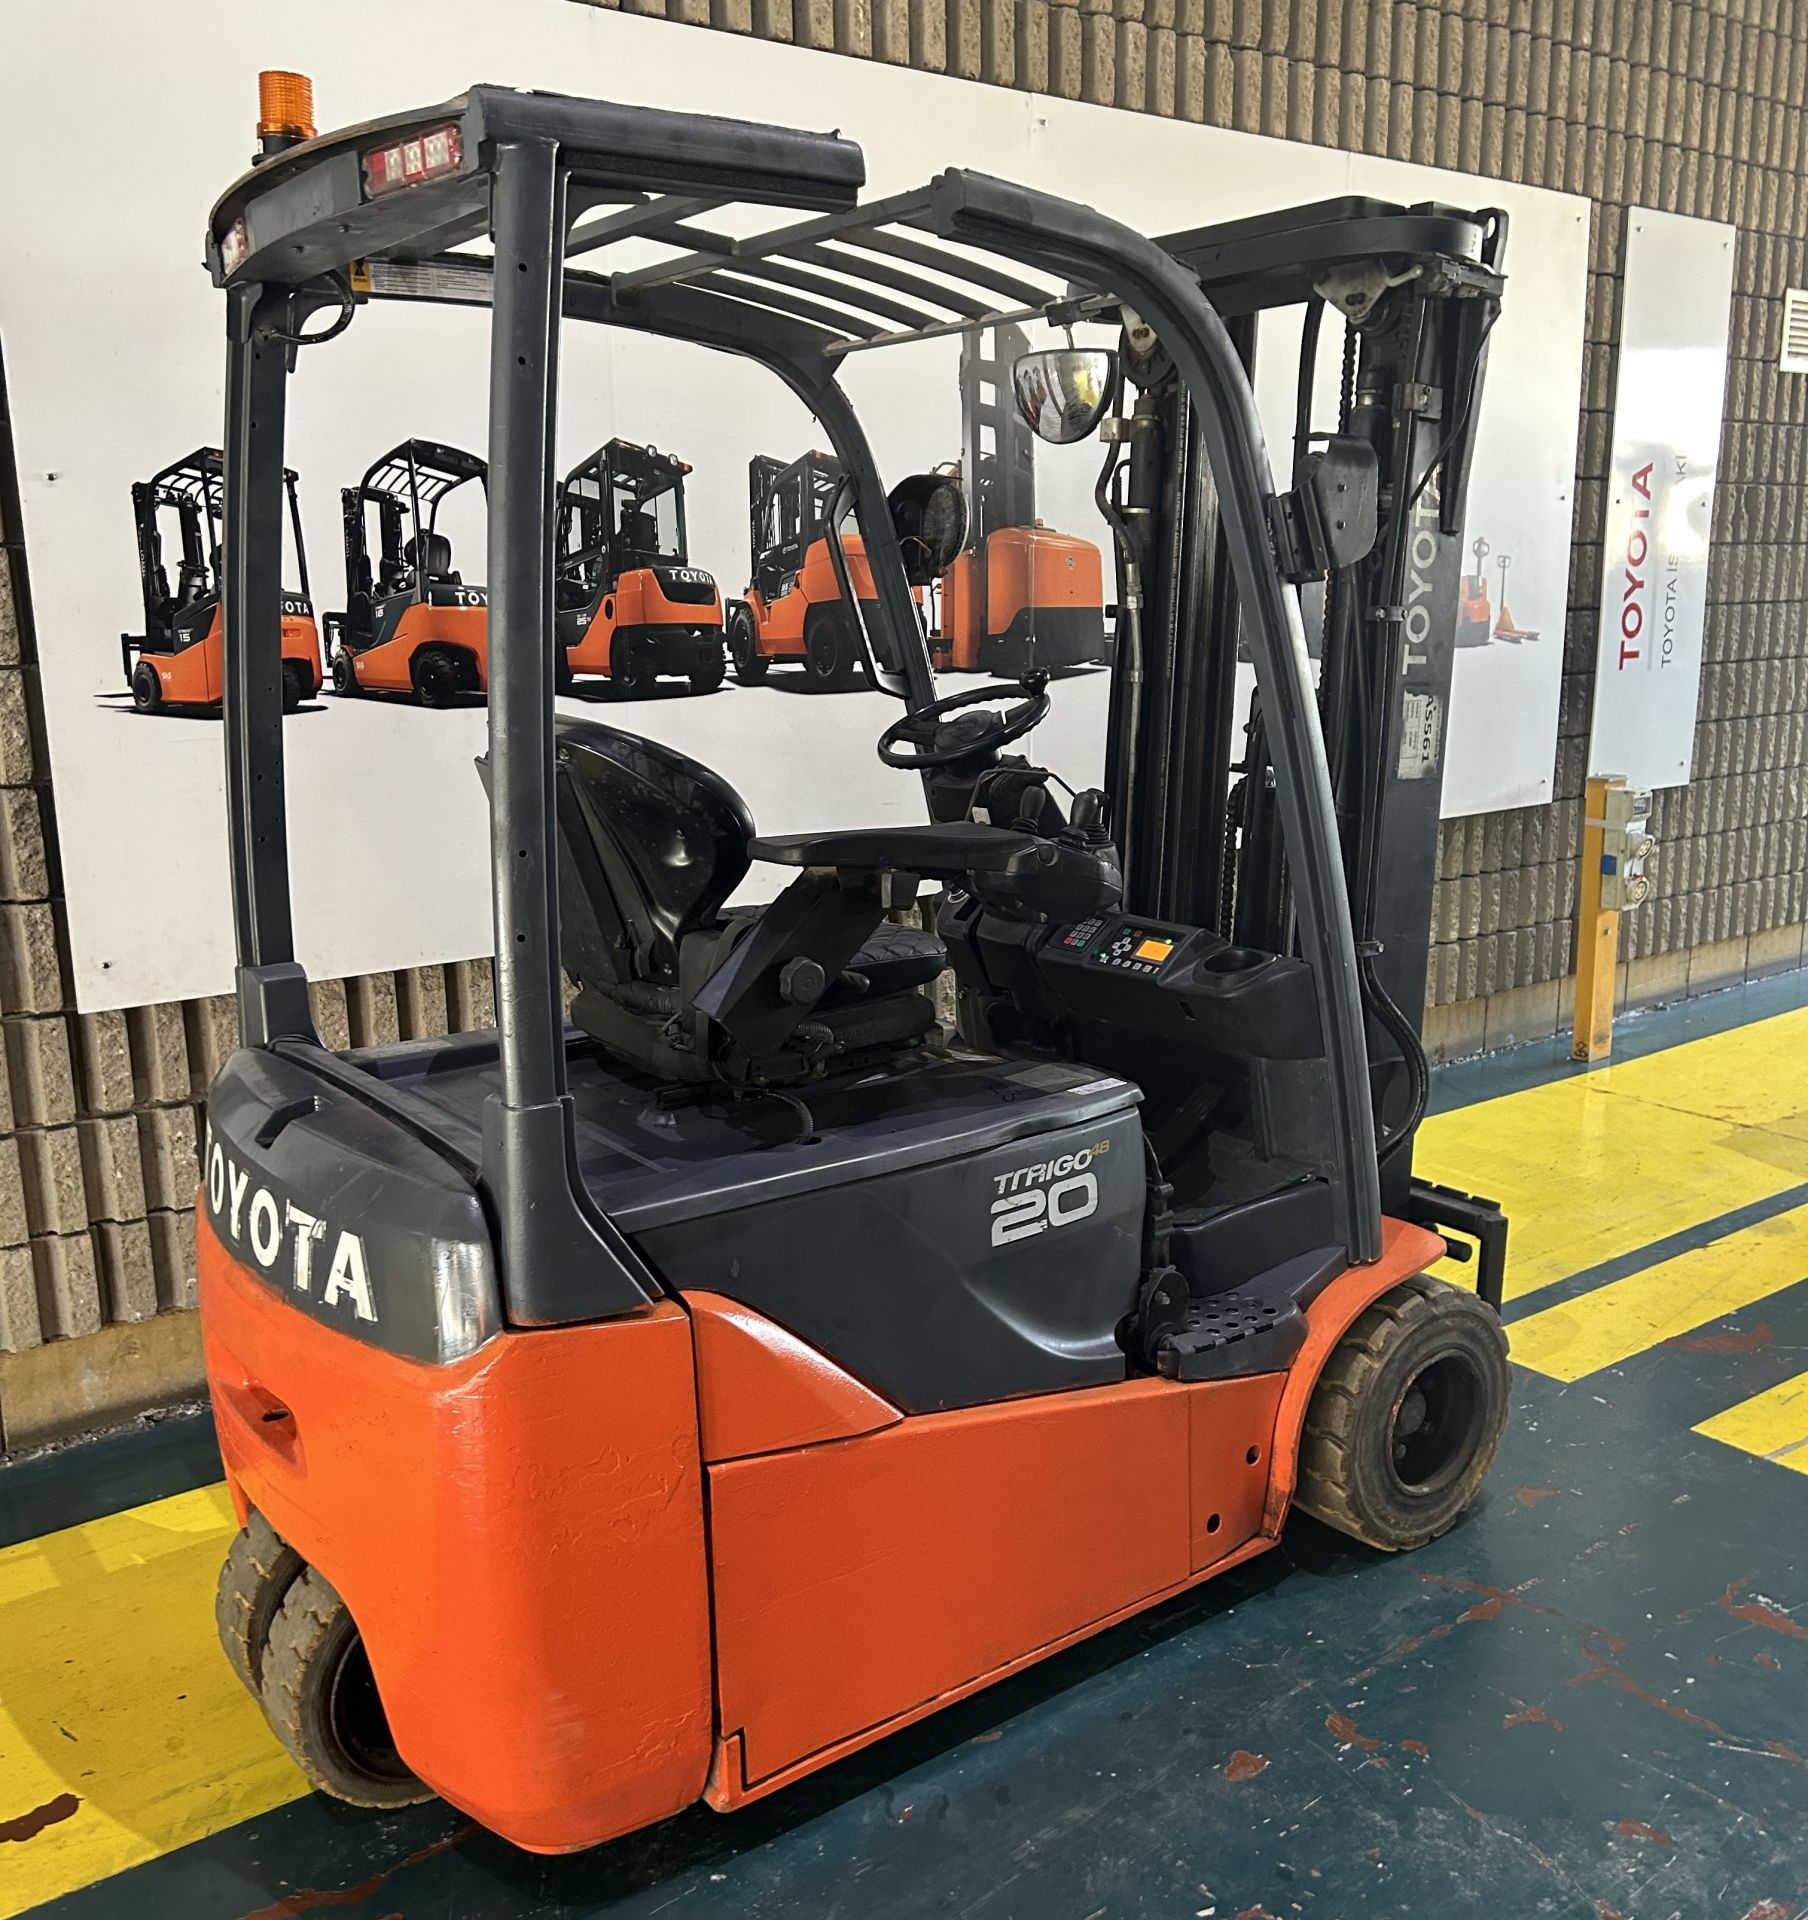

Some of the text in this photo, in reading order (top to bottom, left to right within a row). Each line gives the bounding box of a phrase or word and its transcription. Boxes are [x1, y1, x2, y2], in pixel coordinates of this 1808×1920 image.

[669, 569, 713, 585] TOYOTA
[1661, 578, 1678, 669] TOYOTA
[179, 632, 191, 643] 15
[1088, 1138, 1111, 1157] 48
[990, 1172, 1099, 1248] 20
